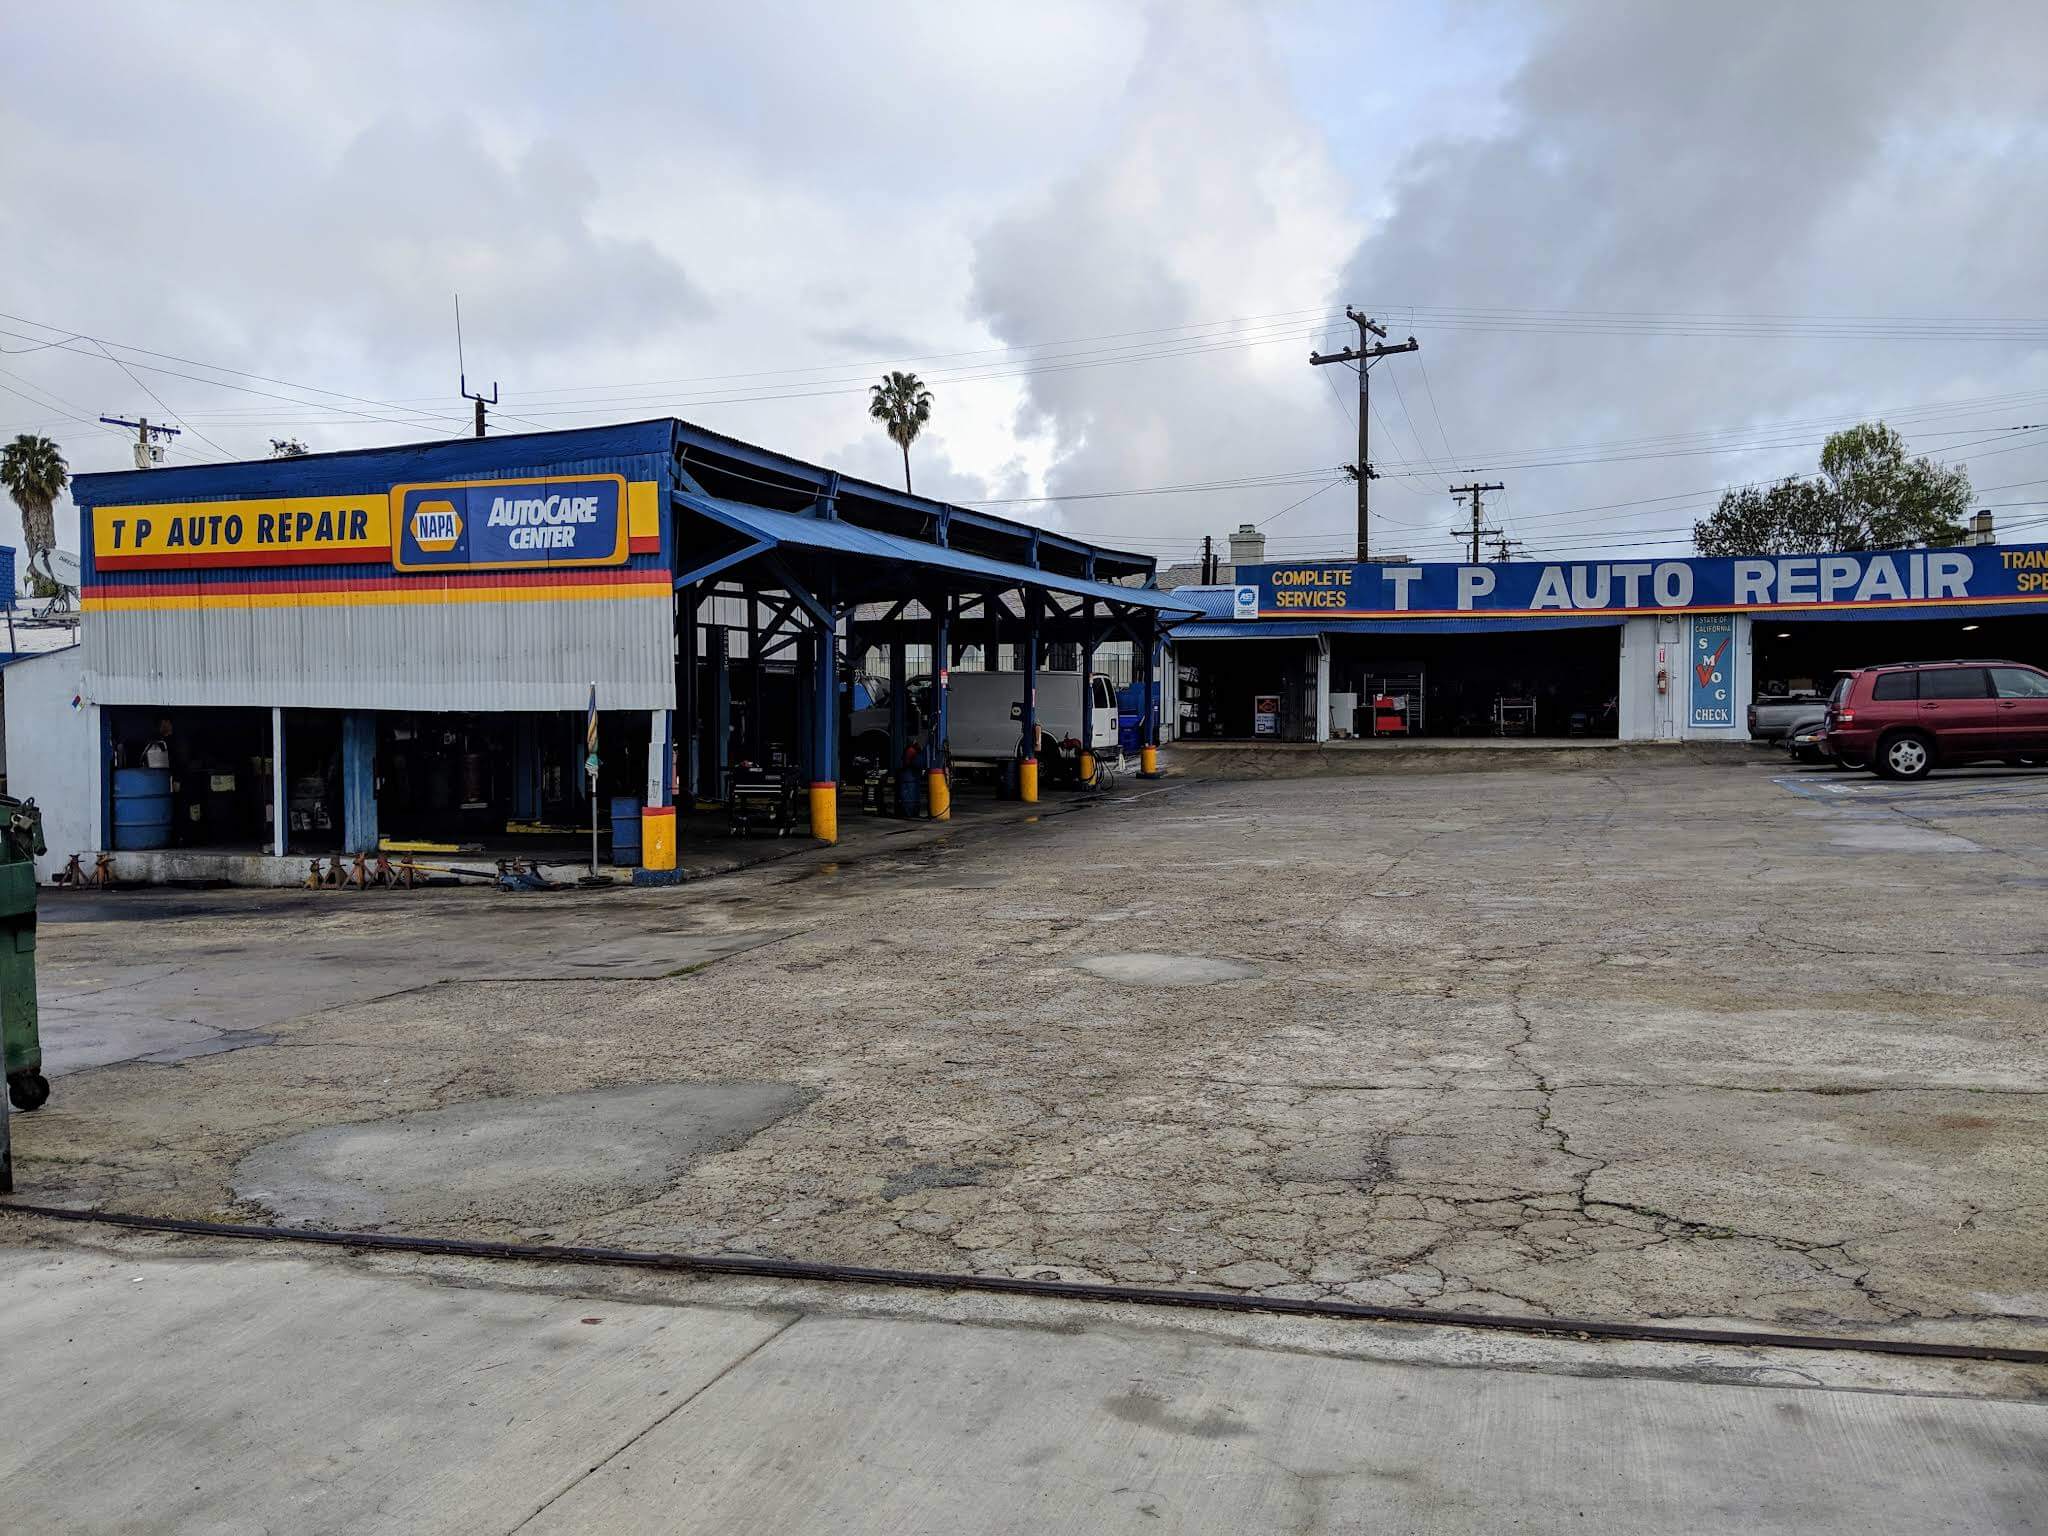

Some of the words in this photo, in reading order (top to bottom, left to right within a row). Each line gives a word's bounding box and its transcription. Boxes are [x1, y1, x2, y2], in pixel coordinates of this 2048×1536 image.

[167, 514, 243, 546] AUTO
[257, 510, 368, 543] REPAIR
[418, 514, 455, 539] NAPA
[508, 526, 575, 549] CENTER
[1272, 570, 1352, 585] COMPLETE
[1382, 567, 1422, 611] T
[1457, 567, 1496, 610] P
[1529, 562, 1693, 609] AUTO
[1734, 552, 1974, 604] REPAIR
[1276, 590, 1346, 607] SERVICES
[1699, 616, 1717, 624] STATE
[1695, 625, 1731, 633] CALIFORNIA
[1695, 708, 1728, 721] CHECK
